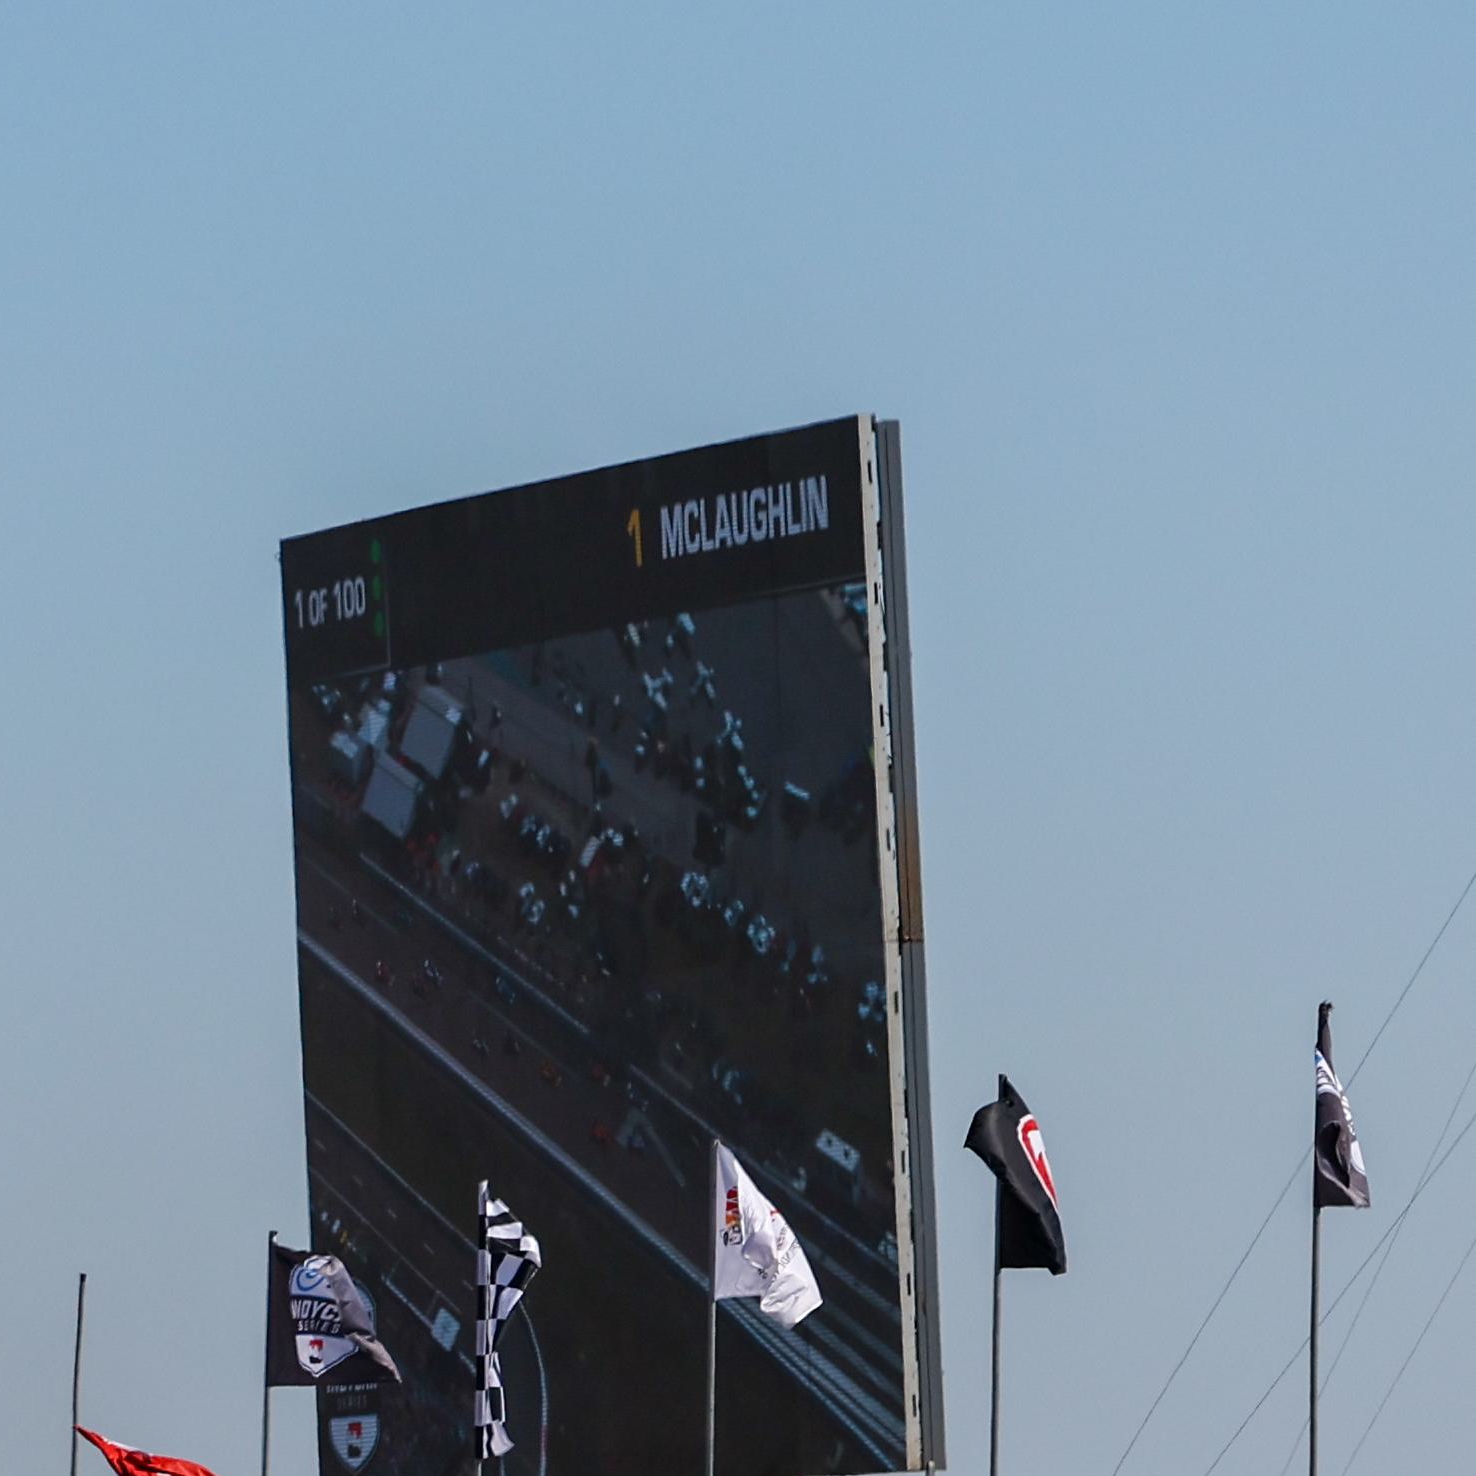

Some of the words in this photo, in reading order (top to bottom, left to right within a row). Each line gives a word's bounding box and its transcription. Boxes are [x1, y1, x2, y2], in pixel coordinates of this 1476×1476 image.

[626, 508, 643, 567] 1
[660, 475, 829, 560] MCLAUGHLIN
[294, 590, 306, 629] 1
[308, 587, 329, 627] OF
[333, 576, 366, 622] 100
